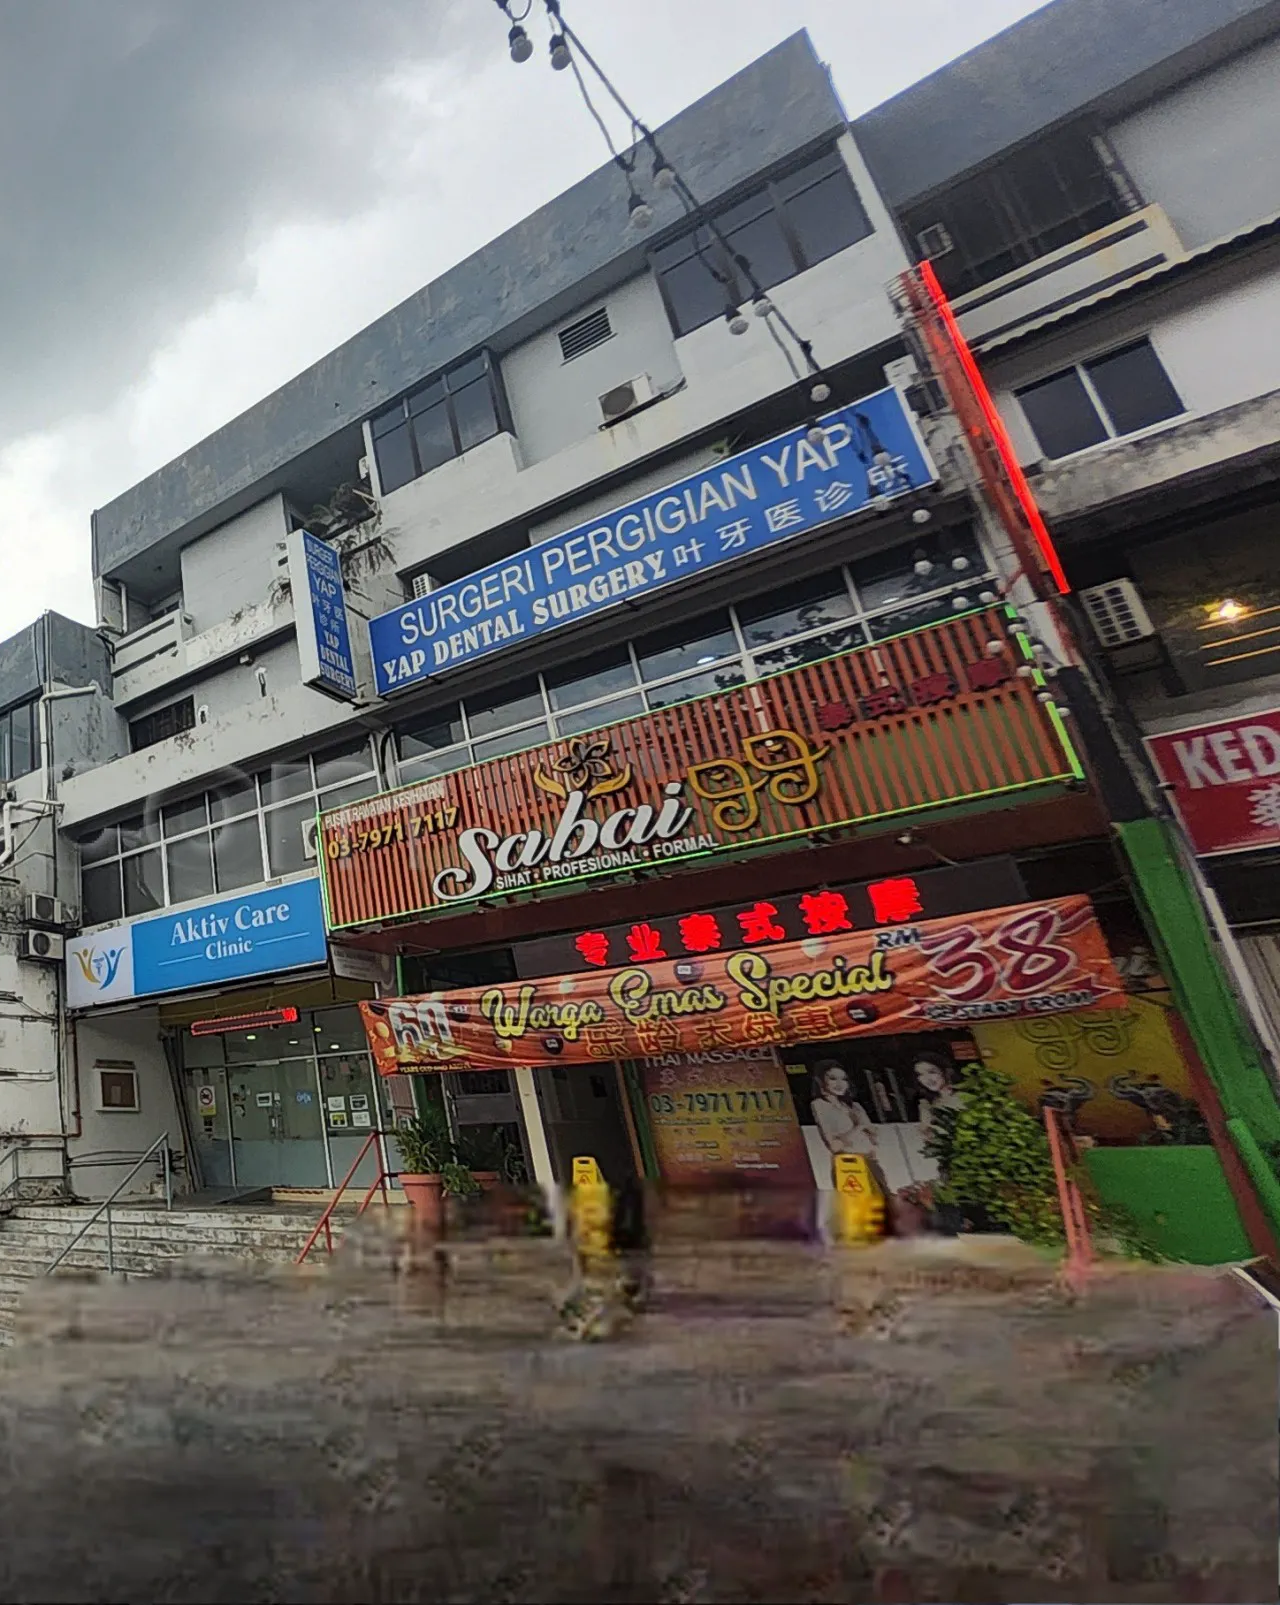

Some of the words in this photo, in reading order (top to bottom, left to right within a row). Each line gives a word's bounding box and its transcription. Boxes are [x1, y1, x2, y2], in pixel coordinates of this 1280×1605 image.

[400, 560, 535, 645] SURGERI
[542, 464, 758, 585] PERGIGIAN
[760, 422, 853, 488] YAP
[312, 574, 337, 599] YAP
[382, 649, 426, 684] YAP
[433, 610, 525, 665] DENTAL
[532, 549, 667, 625] SURGERY
[328, 821, 406, 859] 03-7971
[410, 807, 458, 838] 7117
[432, 783, 694, 900] Sabai
[496, 872, 531, 890] SIHAT
[543, 850, 641, 880] PROFESIONAL
[652, 834, 719, 857] FORMAL
[171, 914, 229, 946] Aktiv
[234, 902, 290, 931] Care
[205, 937, 253, 960] Clinic
[919, 906, 1080, 1003] 38
[480, 985, 603, 1041] Warga
[608, 967, 724, 1026] Emas
[726, 951, 893, 1013] Special
[650, 1092, 733, 1114] 03-7971
[735, 1089, 784, 1111] 7117
